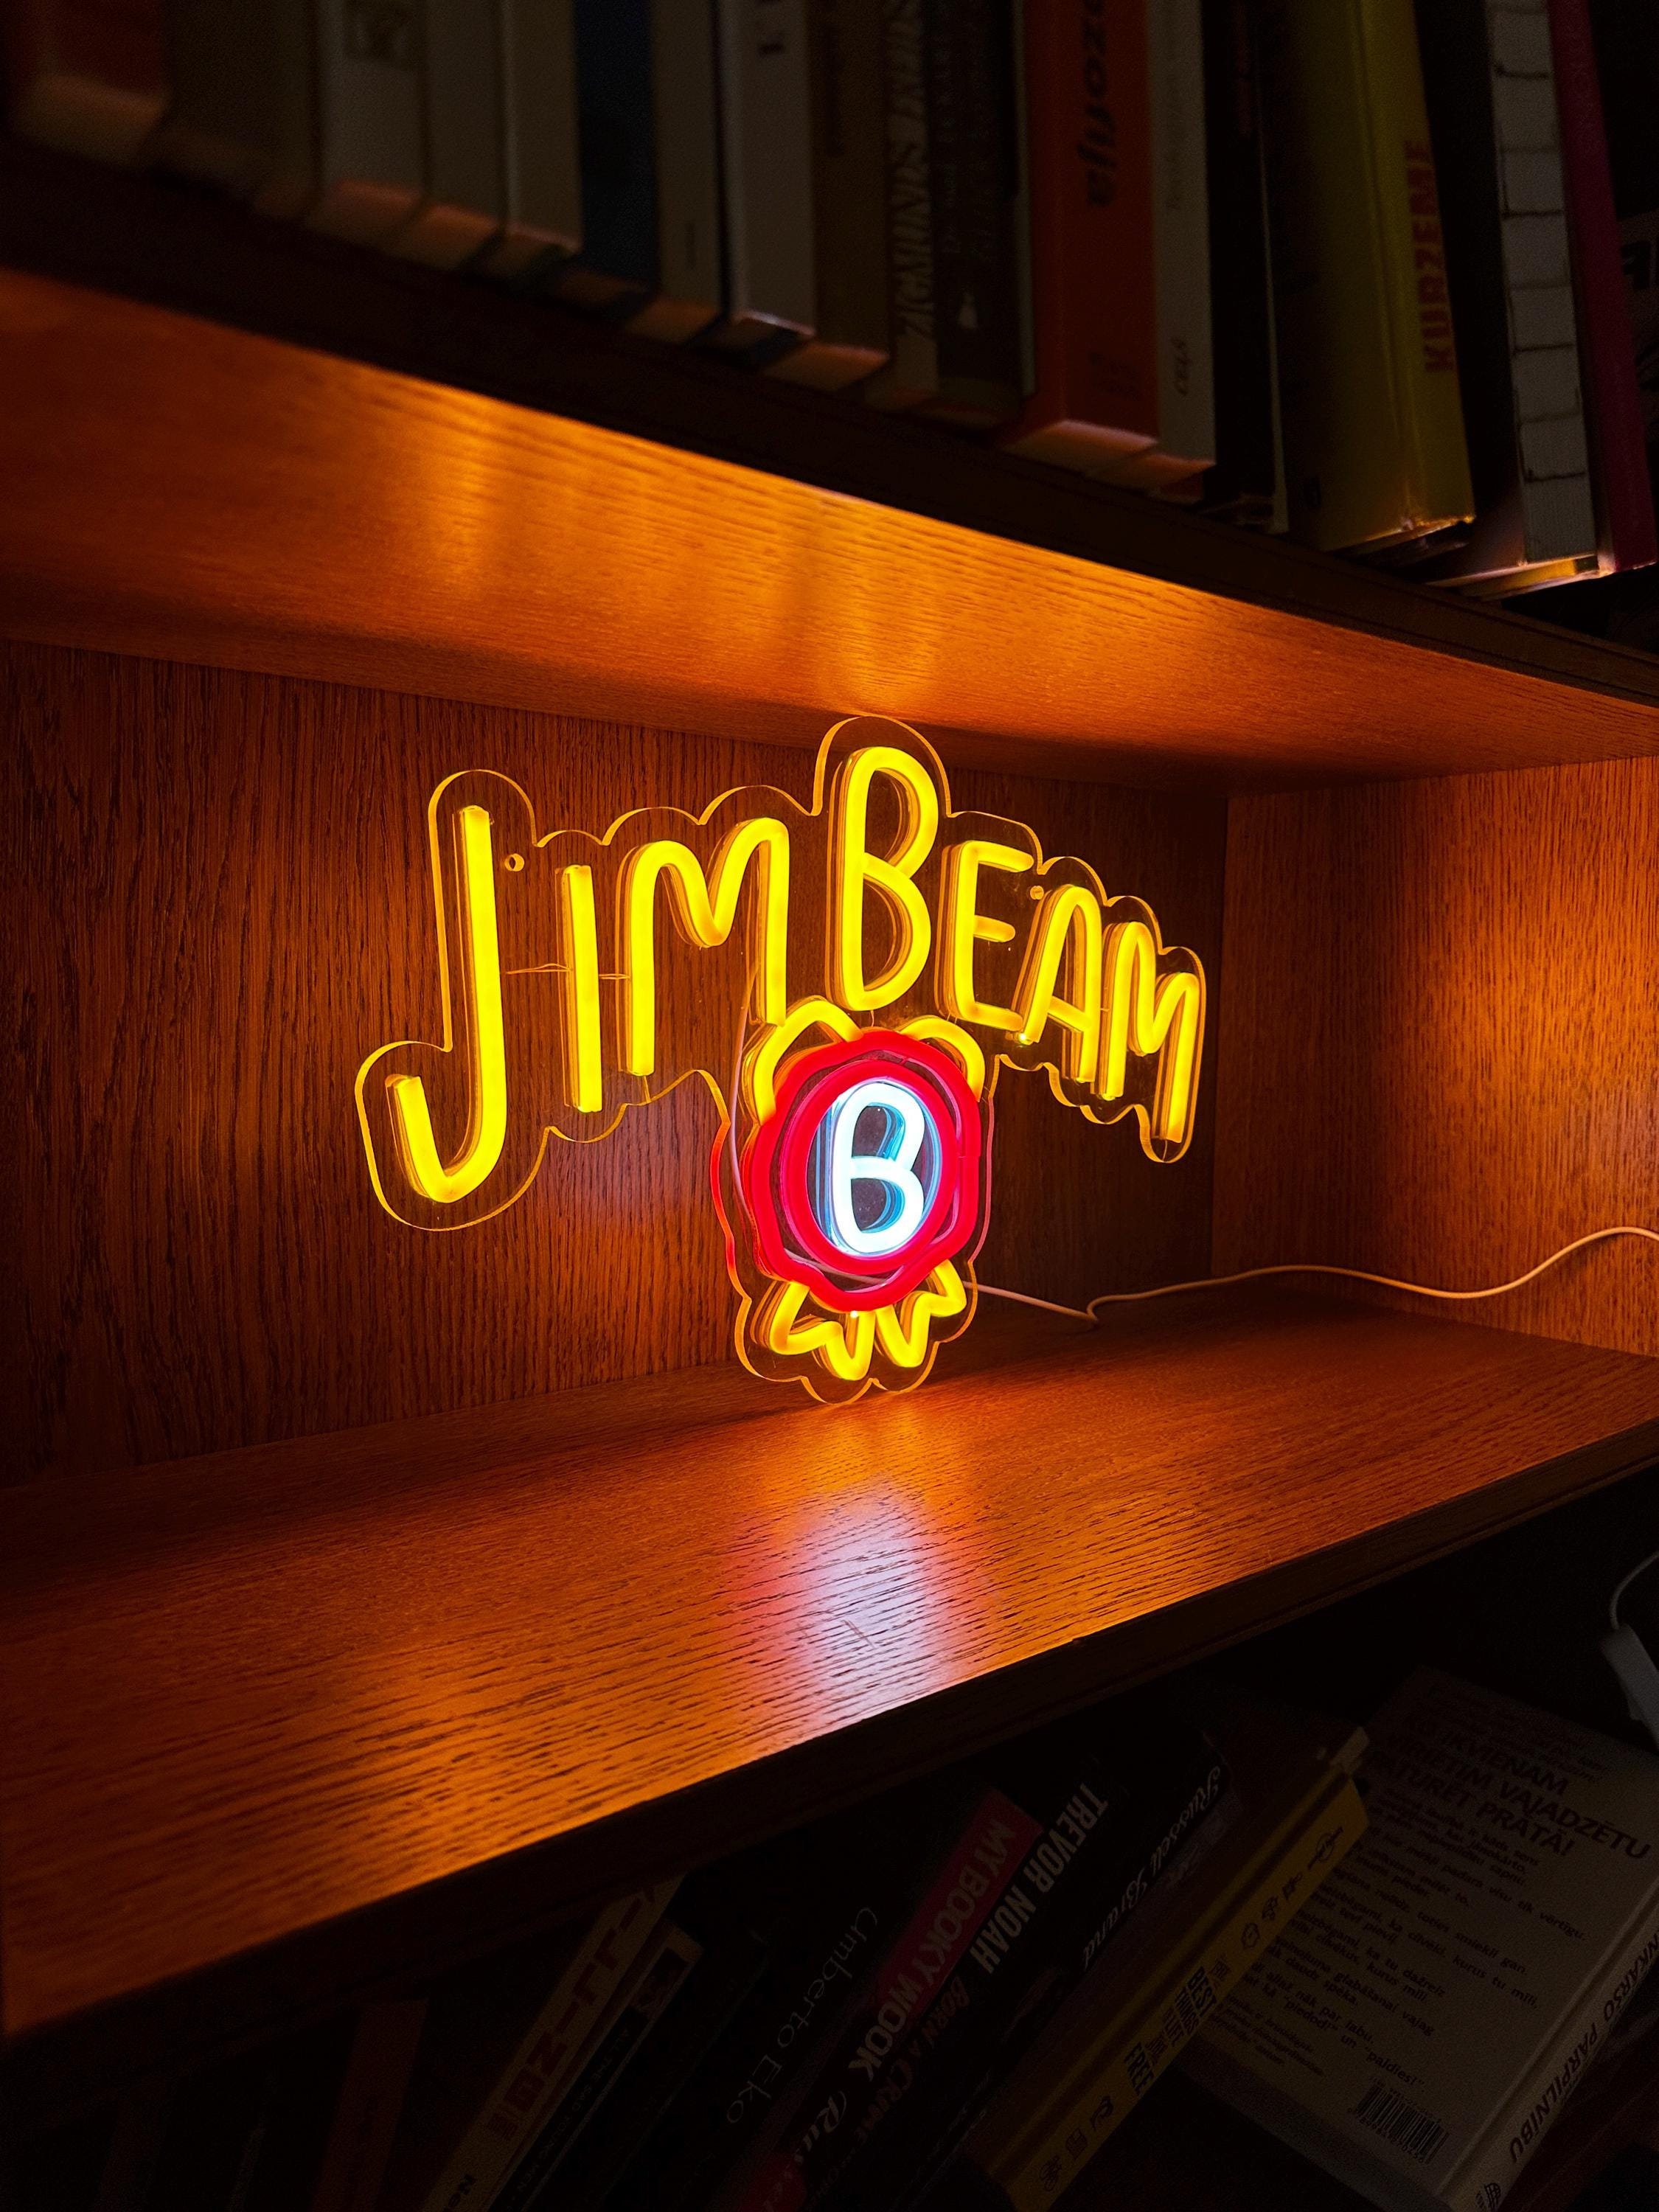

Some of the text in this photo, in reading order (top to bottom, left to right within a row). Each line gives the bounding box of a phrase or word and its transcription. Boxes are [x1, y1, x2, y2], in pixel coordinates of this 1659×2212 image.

[1397, 137, 1458, 374] KURZEME
[384, 743, 1200, 1205] JIM BEAM
[828, 1078, 933, 1256] B
[1082, 1765, 1221, 1969] Russell Brand
[1474, 1794, 1578, 1858] PRĀTĀ!
[1494, 1775, 1654, 1867] VAJADZĒTU
[902, 1871, 980, 1965] BOOKY
[968, 1782, 1108, 1975] TREVOR NOAH
[726, 1905, 879, 2125] Umberto Eko
[1186, 1966, 1217, 2018] BEST
[1365, 1962, 1399, 1989] kurus
[1451, 1953, 1488, 1980] kurus
[1490, 1975, 1507, 1991] tu
[847, 1969, 922, 2083] WOOK
[1124, 2042, 1155, 2097] FREE
[1339, 2033, 1358, 2049] un
[1399, 2009, 1436, 2039] vajag
